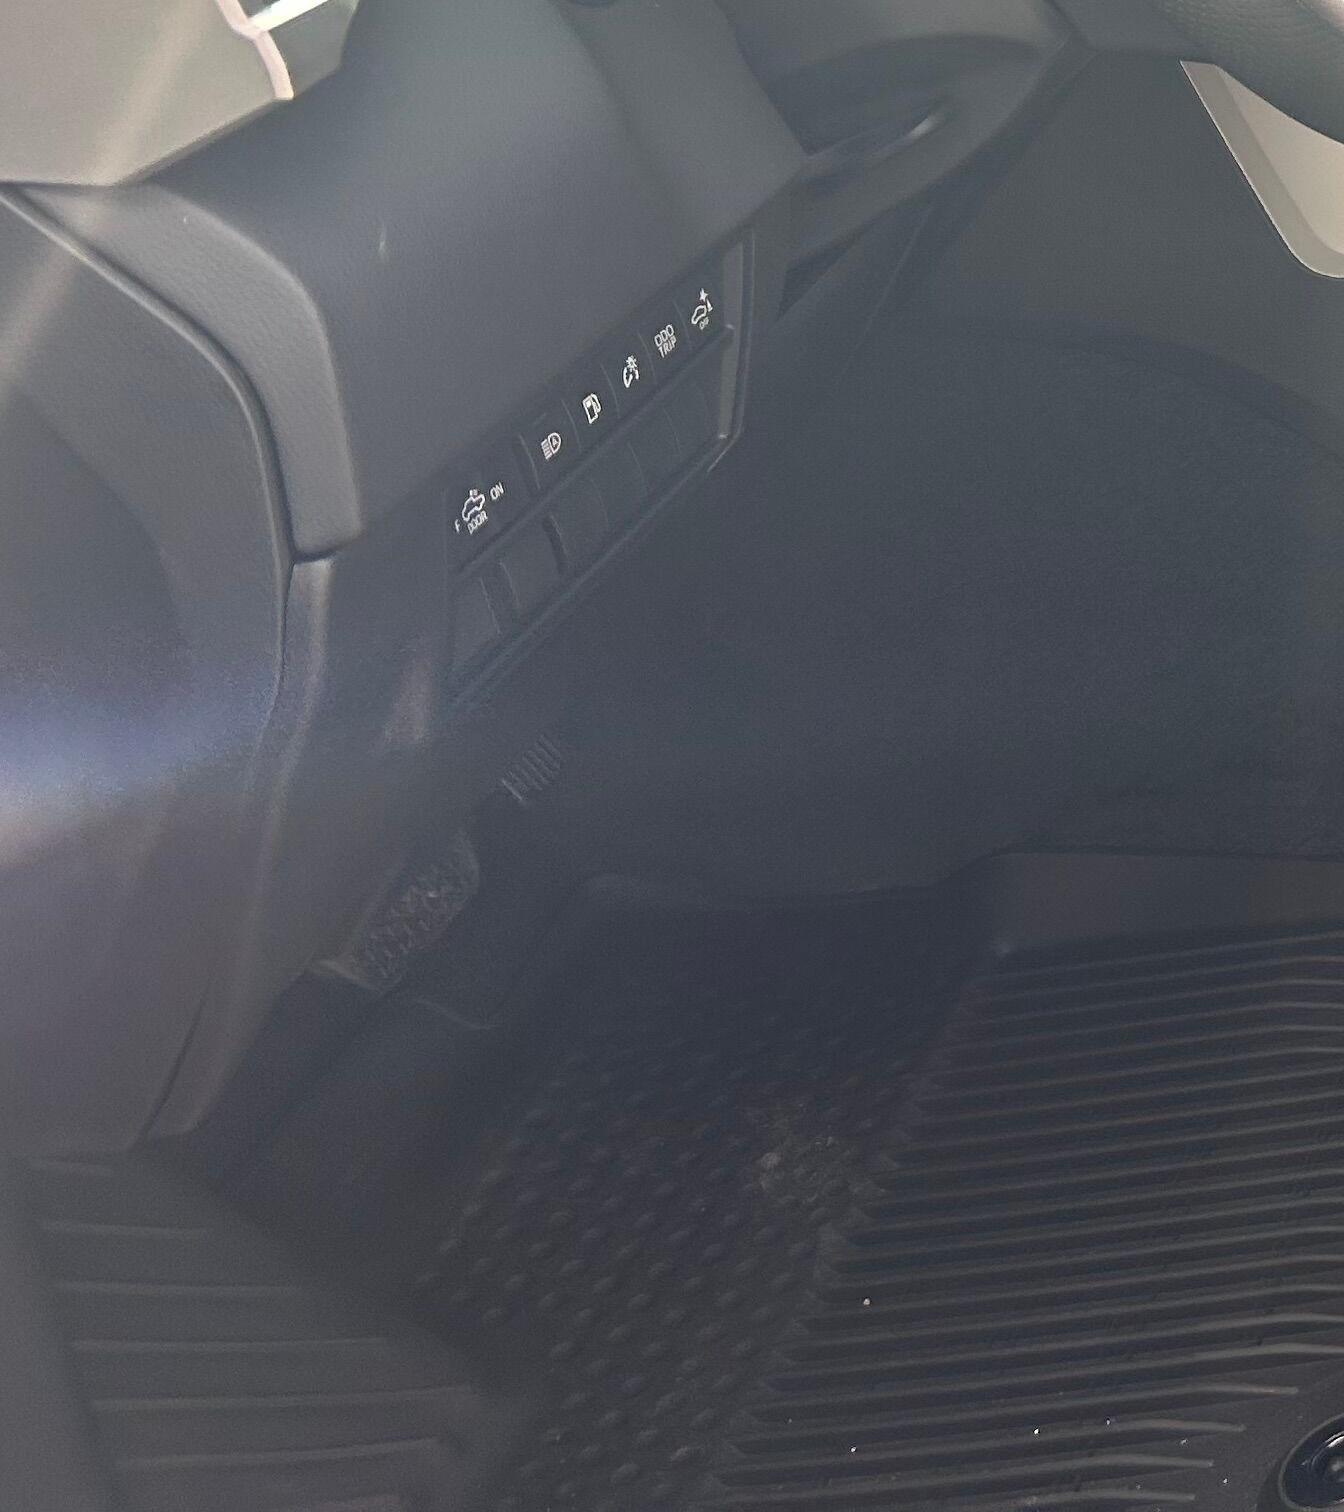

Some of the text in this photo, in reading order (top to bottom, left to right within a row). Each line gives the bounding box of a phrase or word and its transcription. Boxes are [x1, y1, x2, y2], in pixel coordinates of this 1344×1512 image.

[654, 324, 675, 348] ODO
[657, 334, 677, 358] TRIP
[490, 481, 504, 500] ON
[467, 510, 488, 535] DOOR
